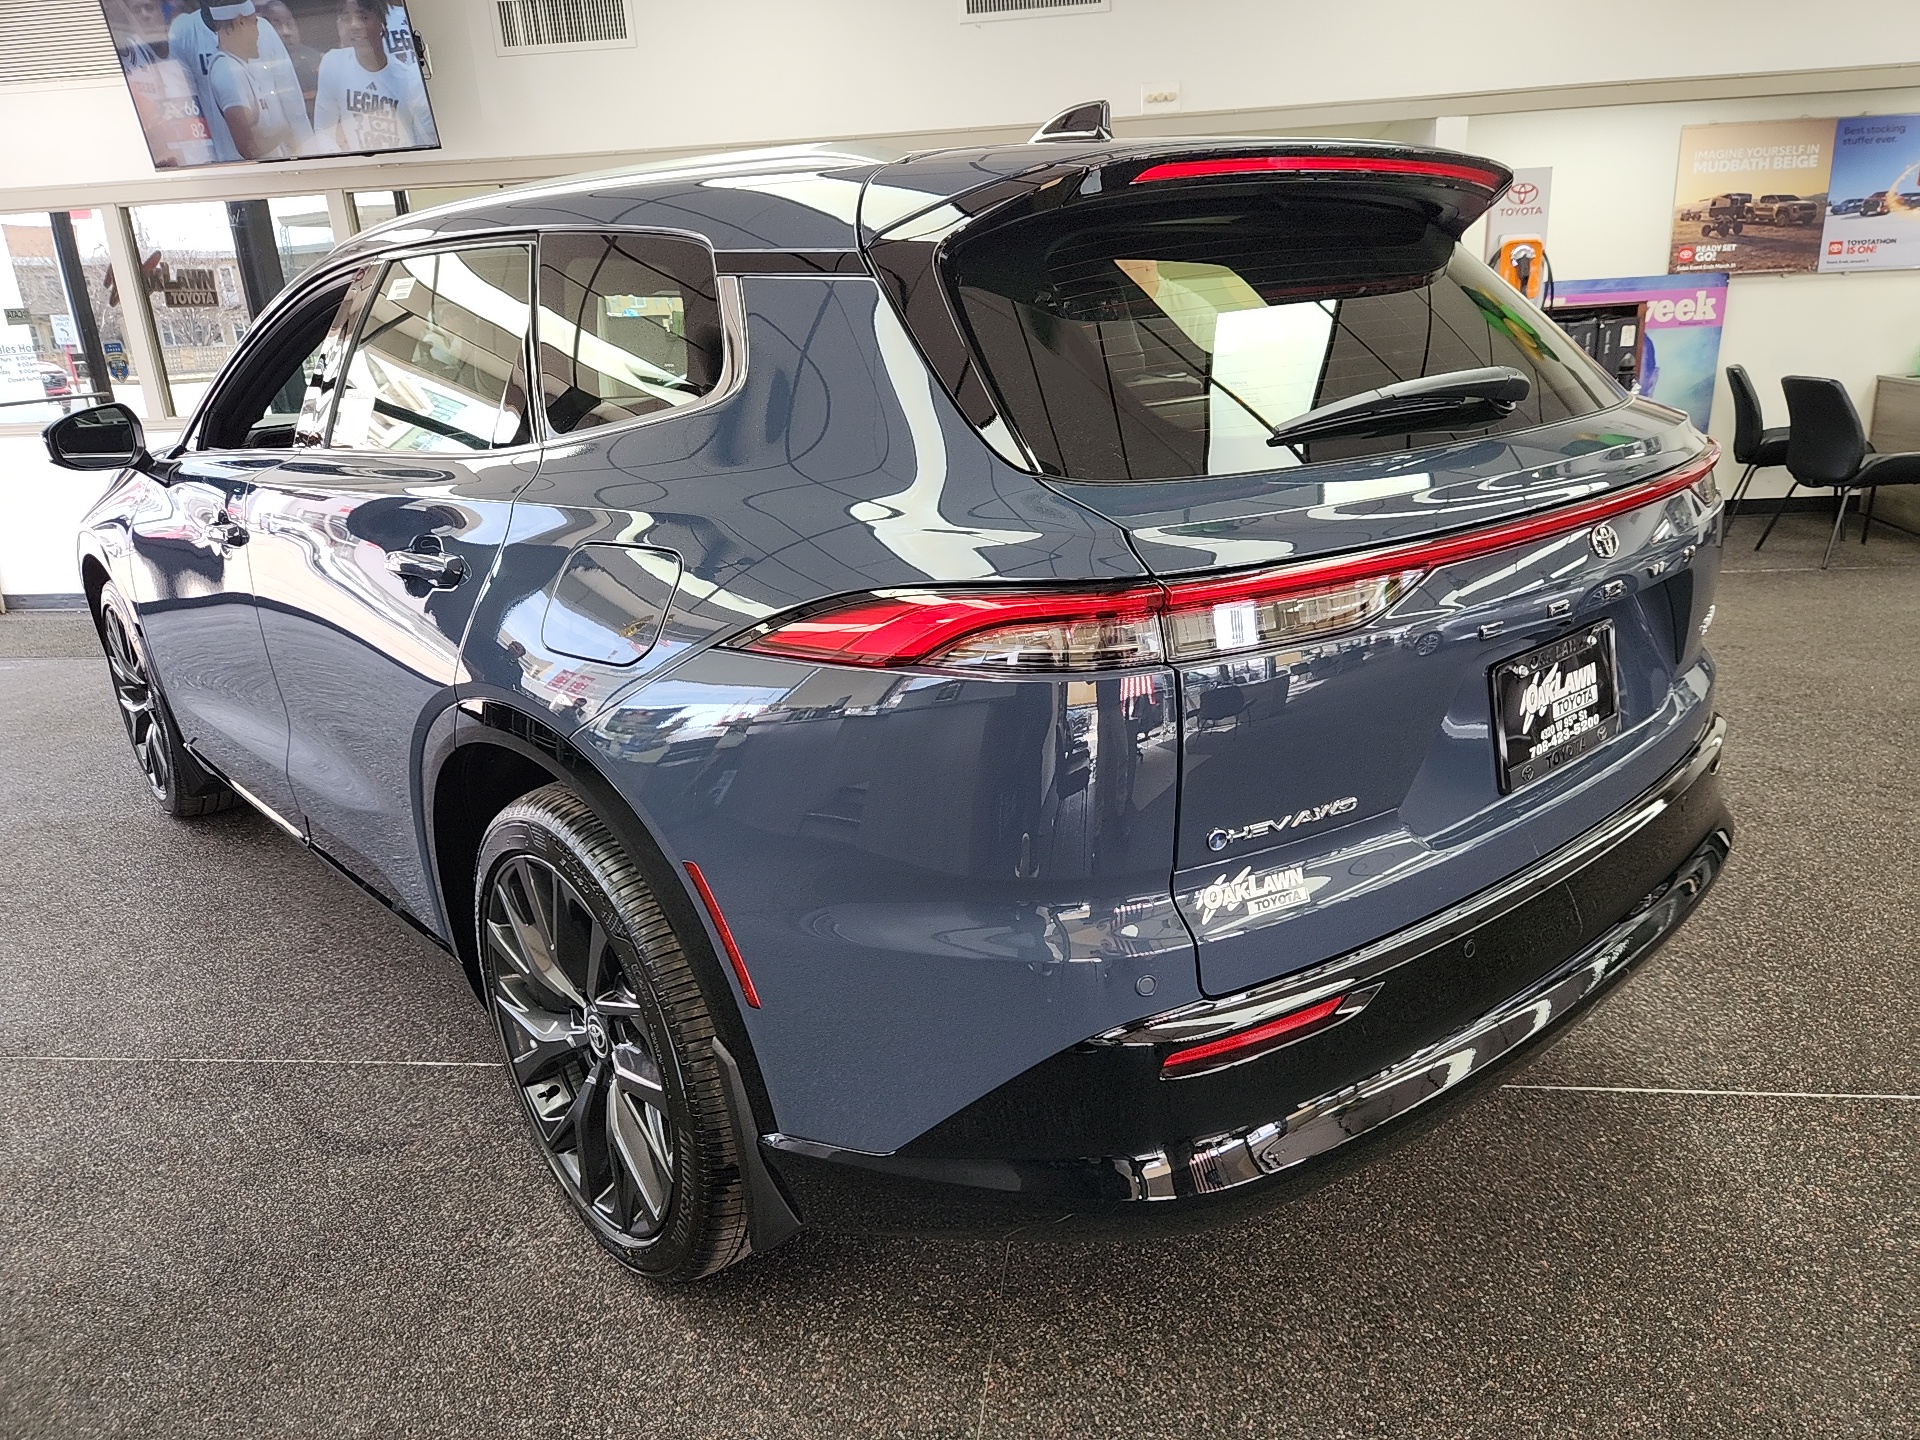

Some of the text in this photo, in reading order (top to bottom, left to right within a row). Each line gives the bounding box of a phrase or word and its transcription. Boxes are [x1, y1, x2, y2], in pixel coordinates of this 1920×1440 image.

[184, 101, 200, 116] 66
[346, 89, 400, 117] LEGACY
[190, 122, 208, 138] 82
[1844, 124, 1907, 136] Best stocking
[1842, 136, 1874, 146] stuffer
[1694, 143, 1820, 161] IMAGINE YOURSELF IN
[1693, 155, 1819, 174] MUDBATH BEIGE
[1500, 206, 1543, 217] TOYOTA
[1694, 251, 1717, 262] GO!
[1695, 244, 1722, 253] READY
[170, 292, 215, 305] TOYOTA
[1523, 662, 1598, 718] OAKLAWN
[1557, 691, 1594, 715] TOYOTA
[1555, 720, 1563, 732] W
[1578, 709, 1588, 722] St
[1529, 713, 1600, 759] 708-423-5200
[1545, 737, 1587, 769] TOYOTA
[1199, 866, 1304, 915] OAKLAWN
[1254, 892, 1301, 912] TOYOTA
